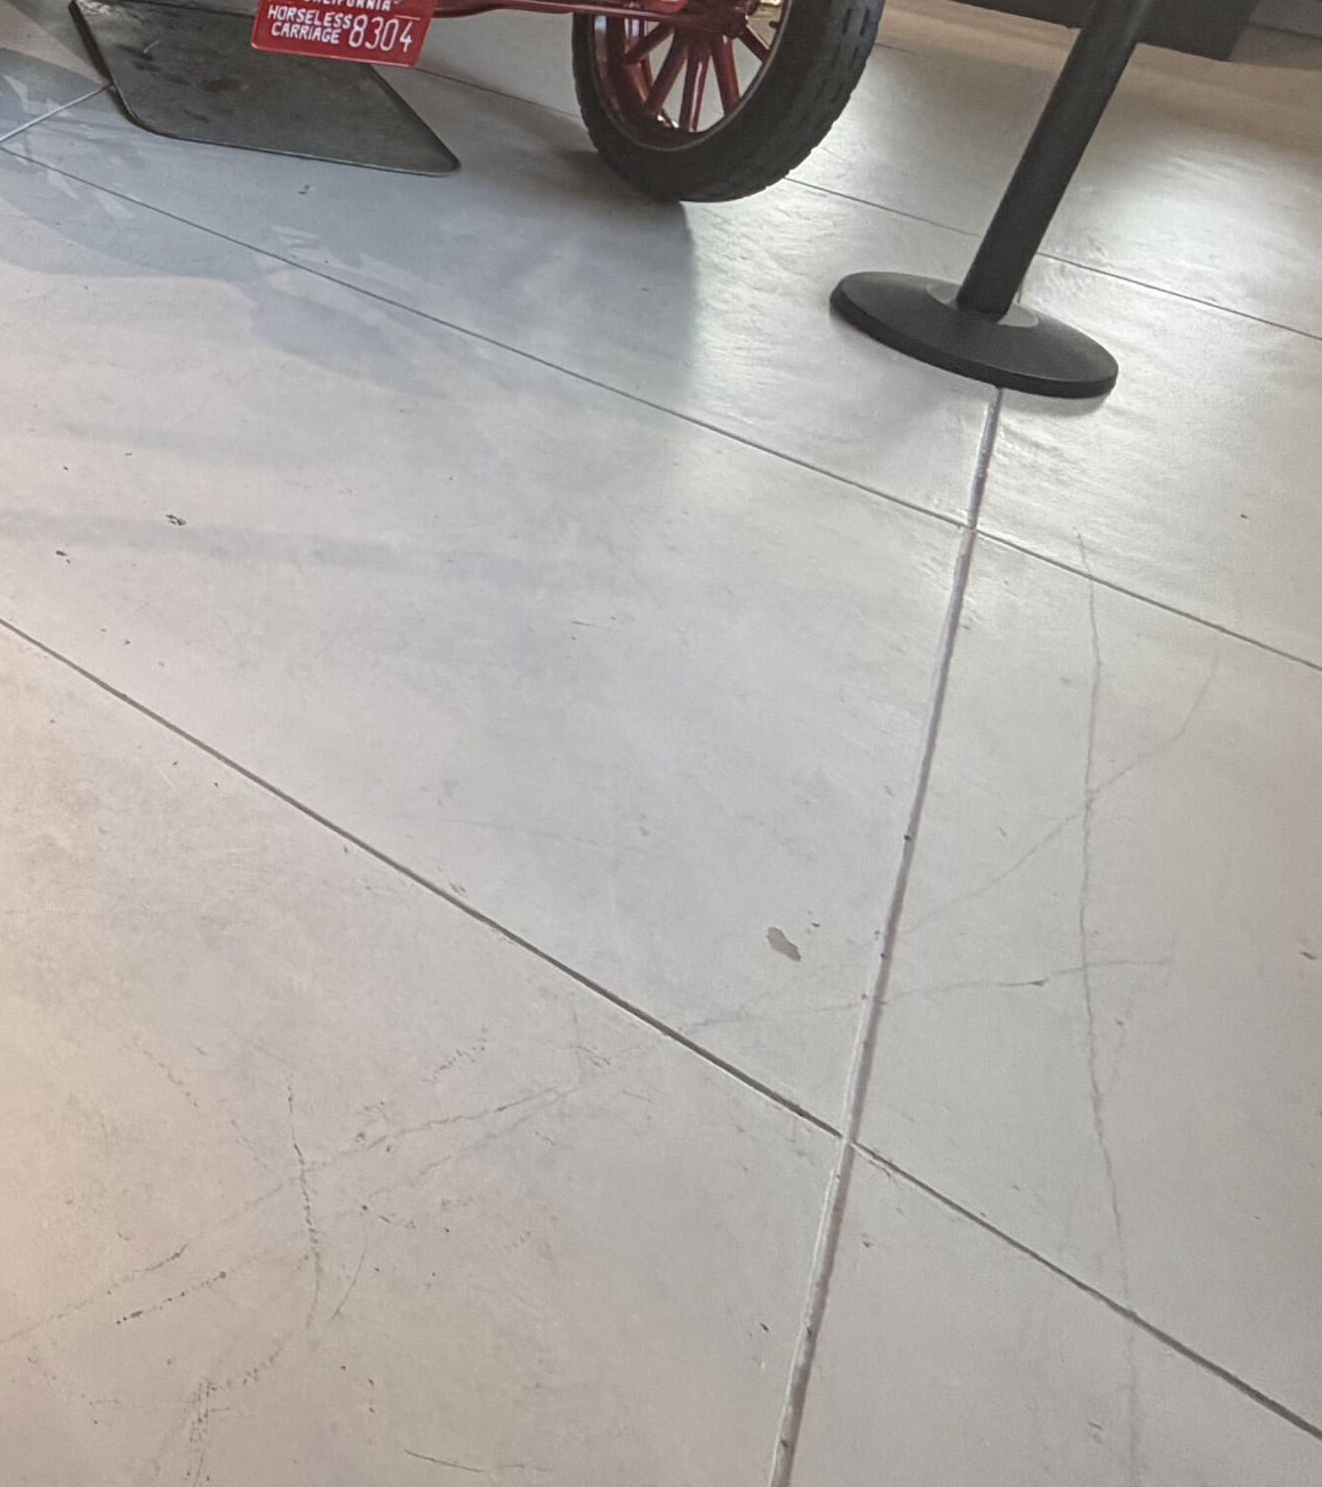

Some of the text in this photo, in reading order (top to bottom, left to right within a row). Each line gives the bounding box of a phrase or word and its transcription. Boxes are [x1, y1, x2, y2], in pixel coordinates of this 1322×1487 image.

[268, 5, 351, 29] HORSELESS
[271, 14, 413, 53] CARRIAGE 8304
